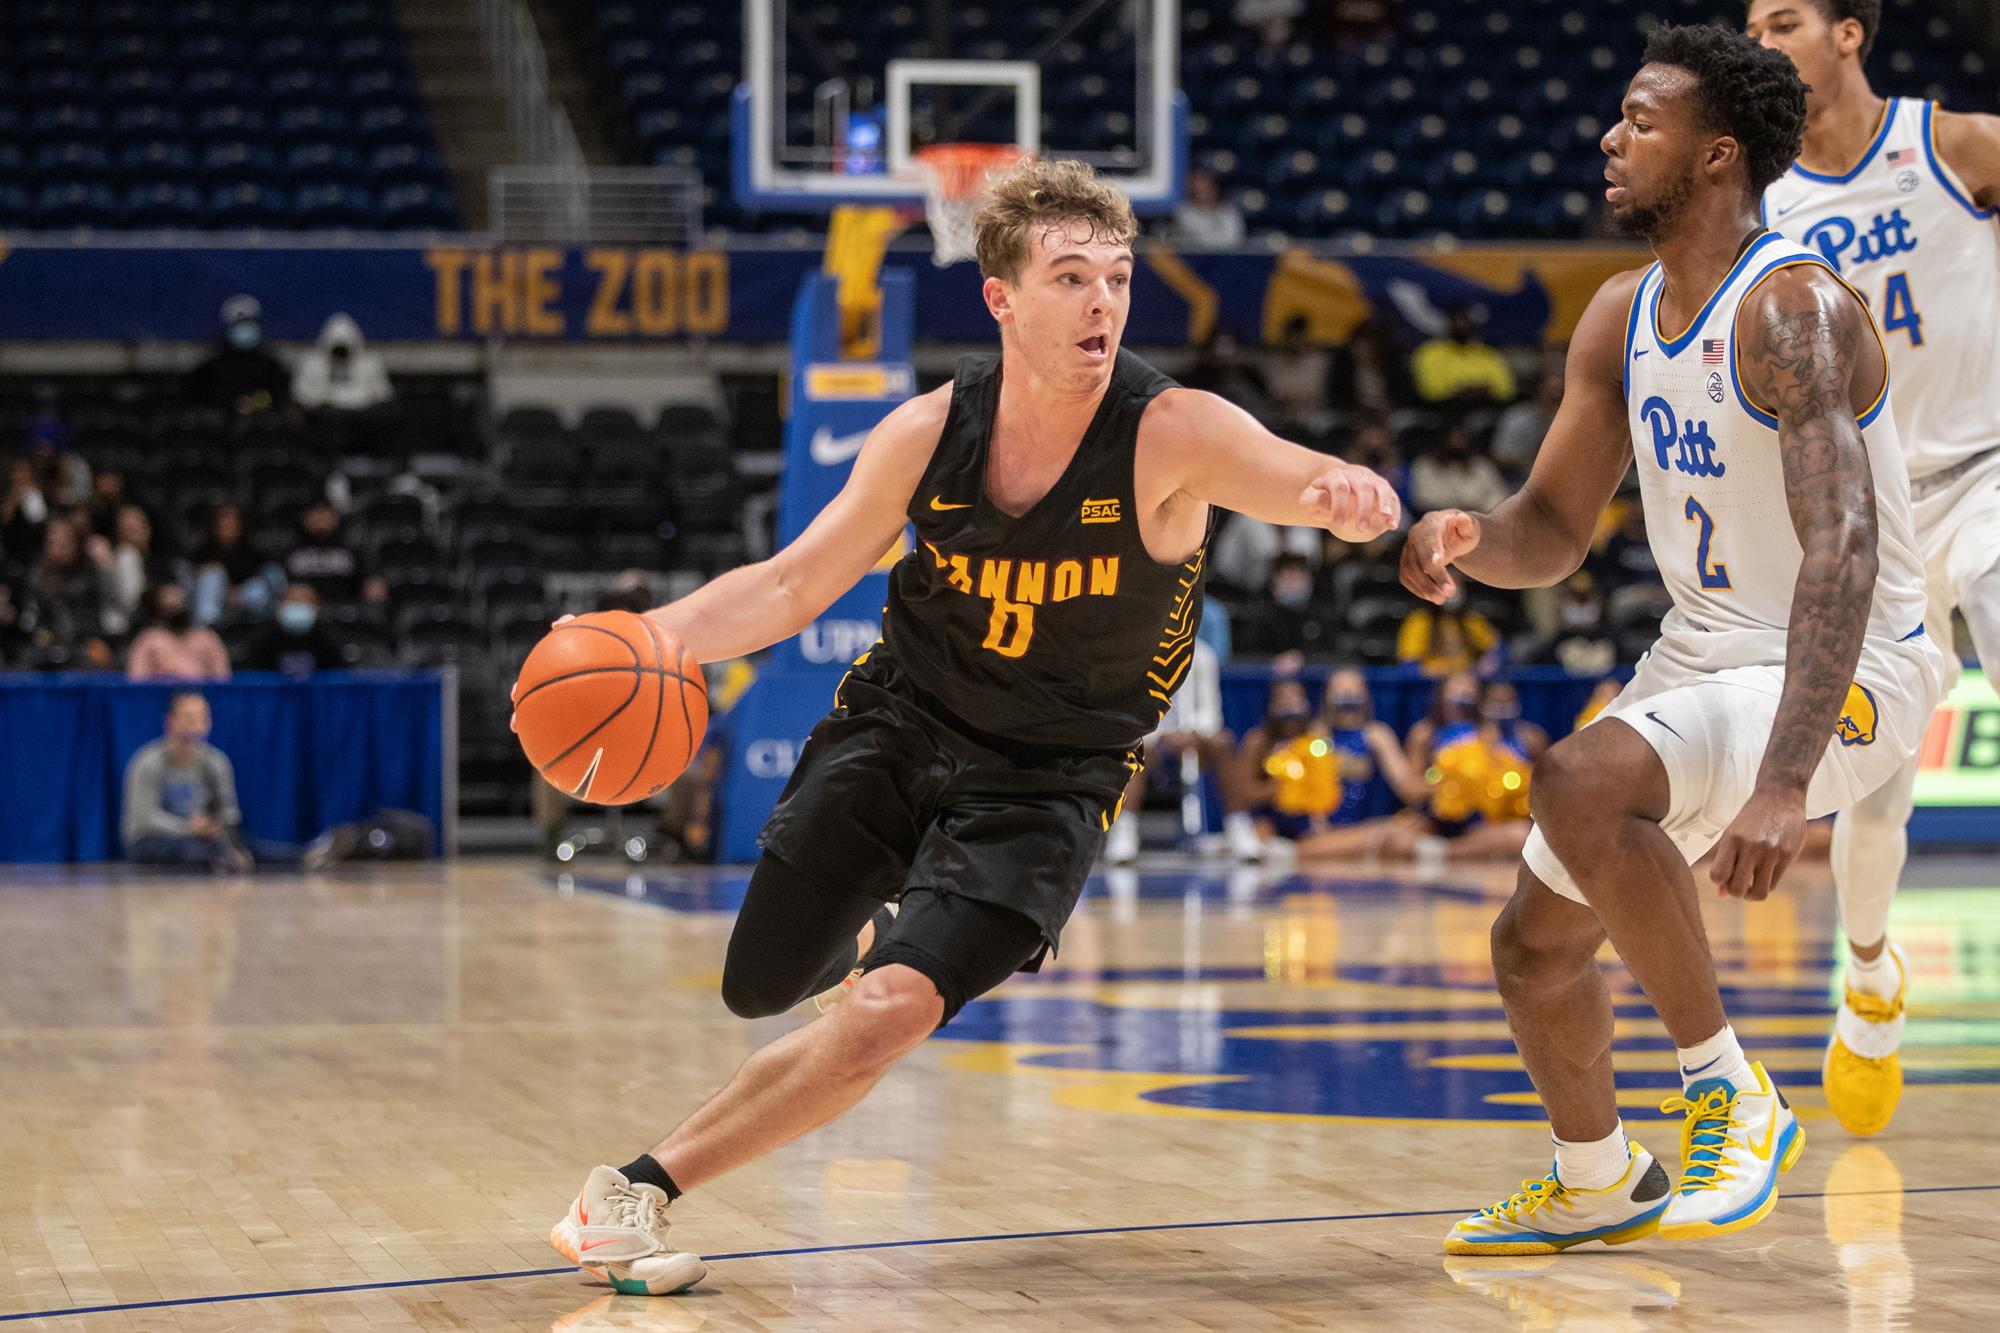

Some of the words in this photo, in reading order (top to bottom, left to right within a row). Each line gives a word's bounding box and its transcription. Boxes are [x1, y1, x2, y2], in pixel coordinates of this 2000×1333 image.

[1803, 208, 1918, 273] Pitt
[425, 247, 564, 336] THE
[586, 250, 730, 336] ZOO
[1641, 396, 1726, 478] Pitt
[1081, 503, 1121, 519] PSAC
[1684, 495, 1735, 592] 2
[924, 542, 1120, 606] ANNON
